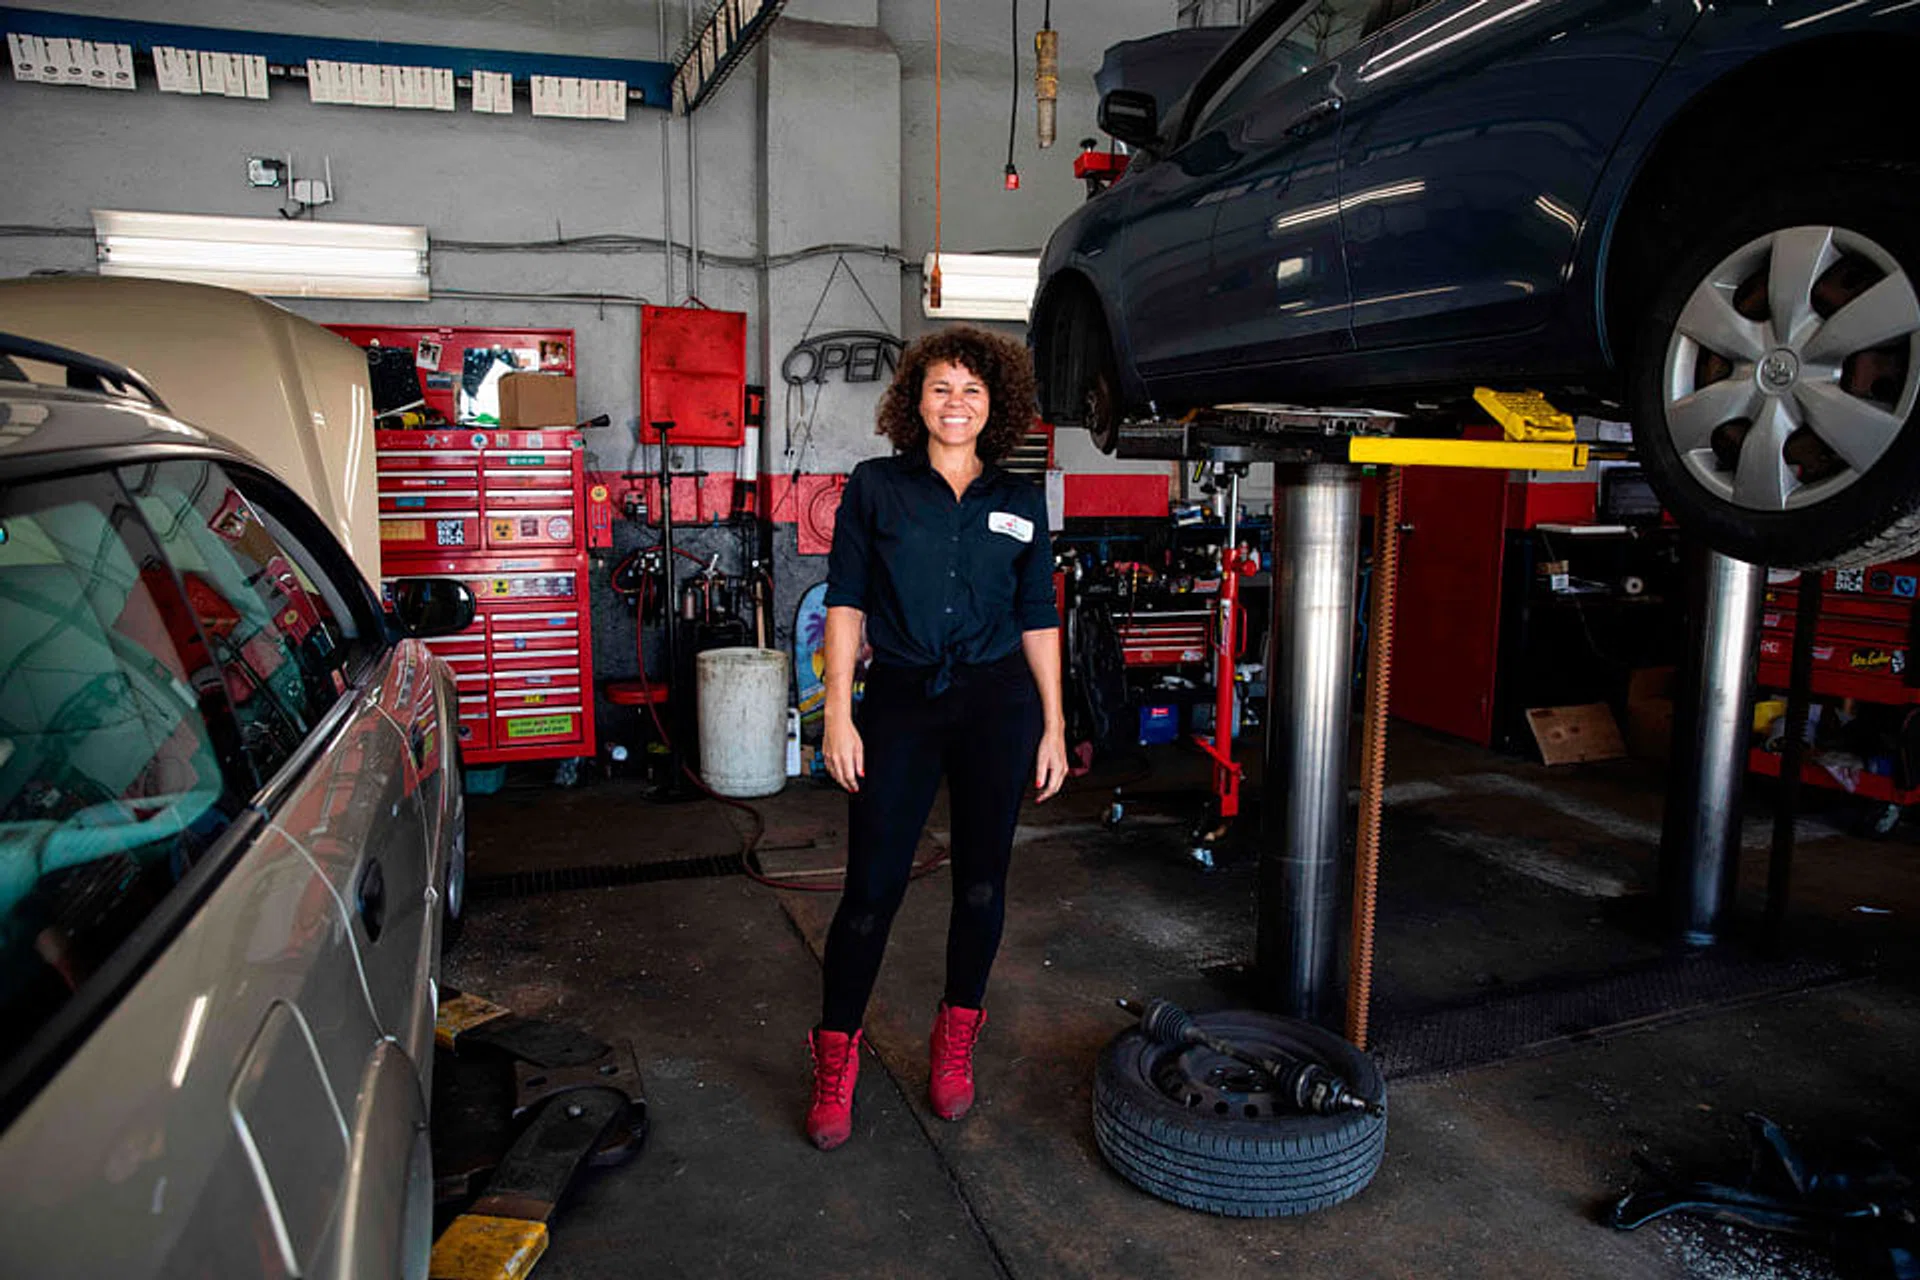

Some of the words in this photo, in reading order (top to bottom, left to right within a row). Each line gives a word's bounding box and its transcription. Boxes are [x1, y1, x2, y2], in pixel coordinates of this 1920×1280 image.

[782, 341, 898, 385] OPEN
[437, 520, 463, 528] DON'T
[438, 529, 451, 537] BE
[438, 537, 464, 545] DICK
